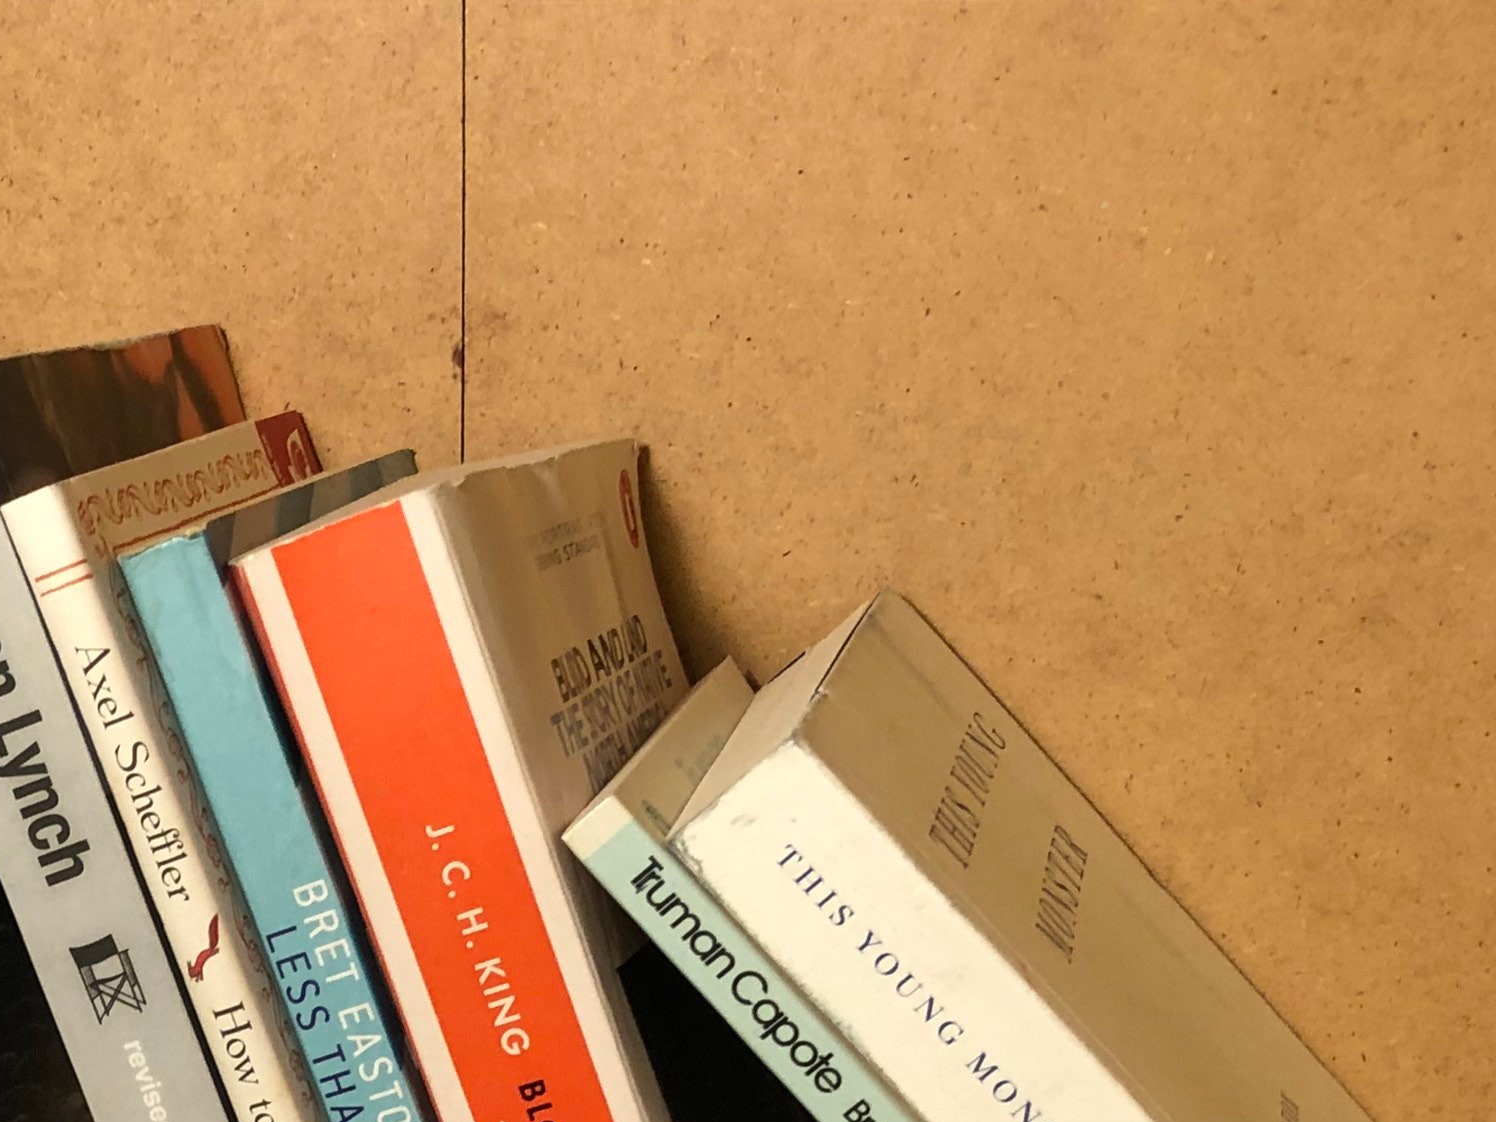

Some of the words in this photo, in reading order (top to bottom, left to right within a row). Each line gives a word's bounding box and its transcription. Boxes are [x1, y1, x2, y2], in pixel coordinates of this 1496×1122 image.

[74, 645, 135, 731] Axel
[114, 741, 191, 902] Scheffler
[212, 1000, 261, 1087] How
[425, 823, 455, 852] J.
[442, 860, 472, 898] C.
[264, 924, 331, 1031] LESS
[291, 878, 362, 986] BRET
[456, 906, 489, 950] H.
[630, 855, 735, 979] Truman
[731, 970, 844, 1094] Capote
[776, 843, 856, 928] THIS
[855, 929, 965, 1046] YOUNG
[473, 956, 532, 1056] KING
